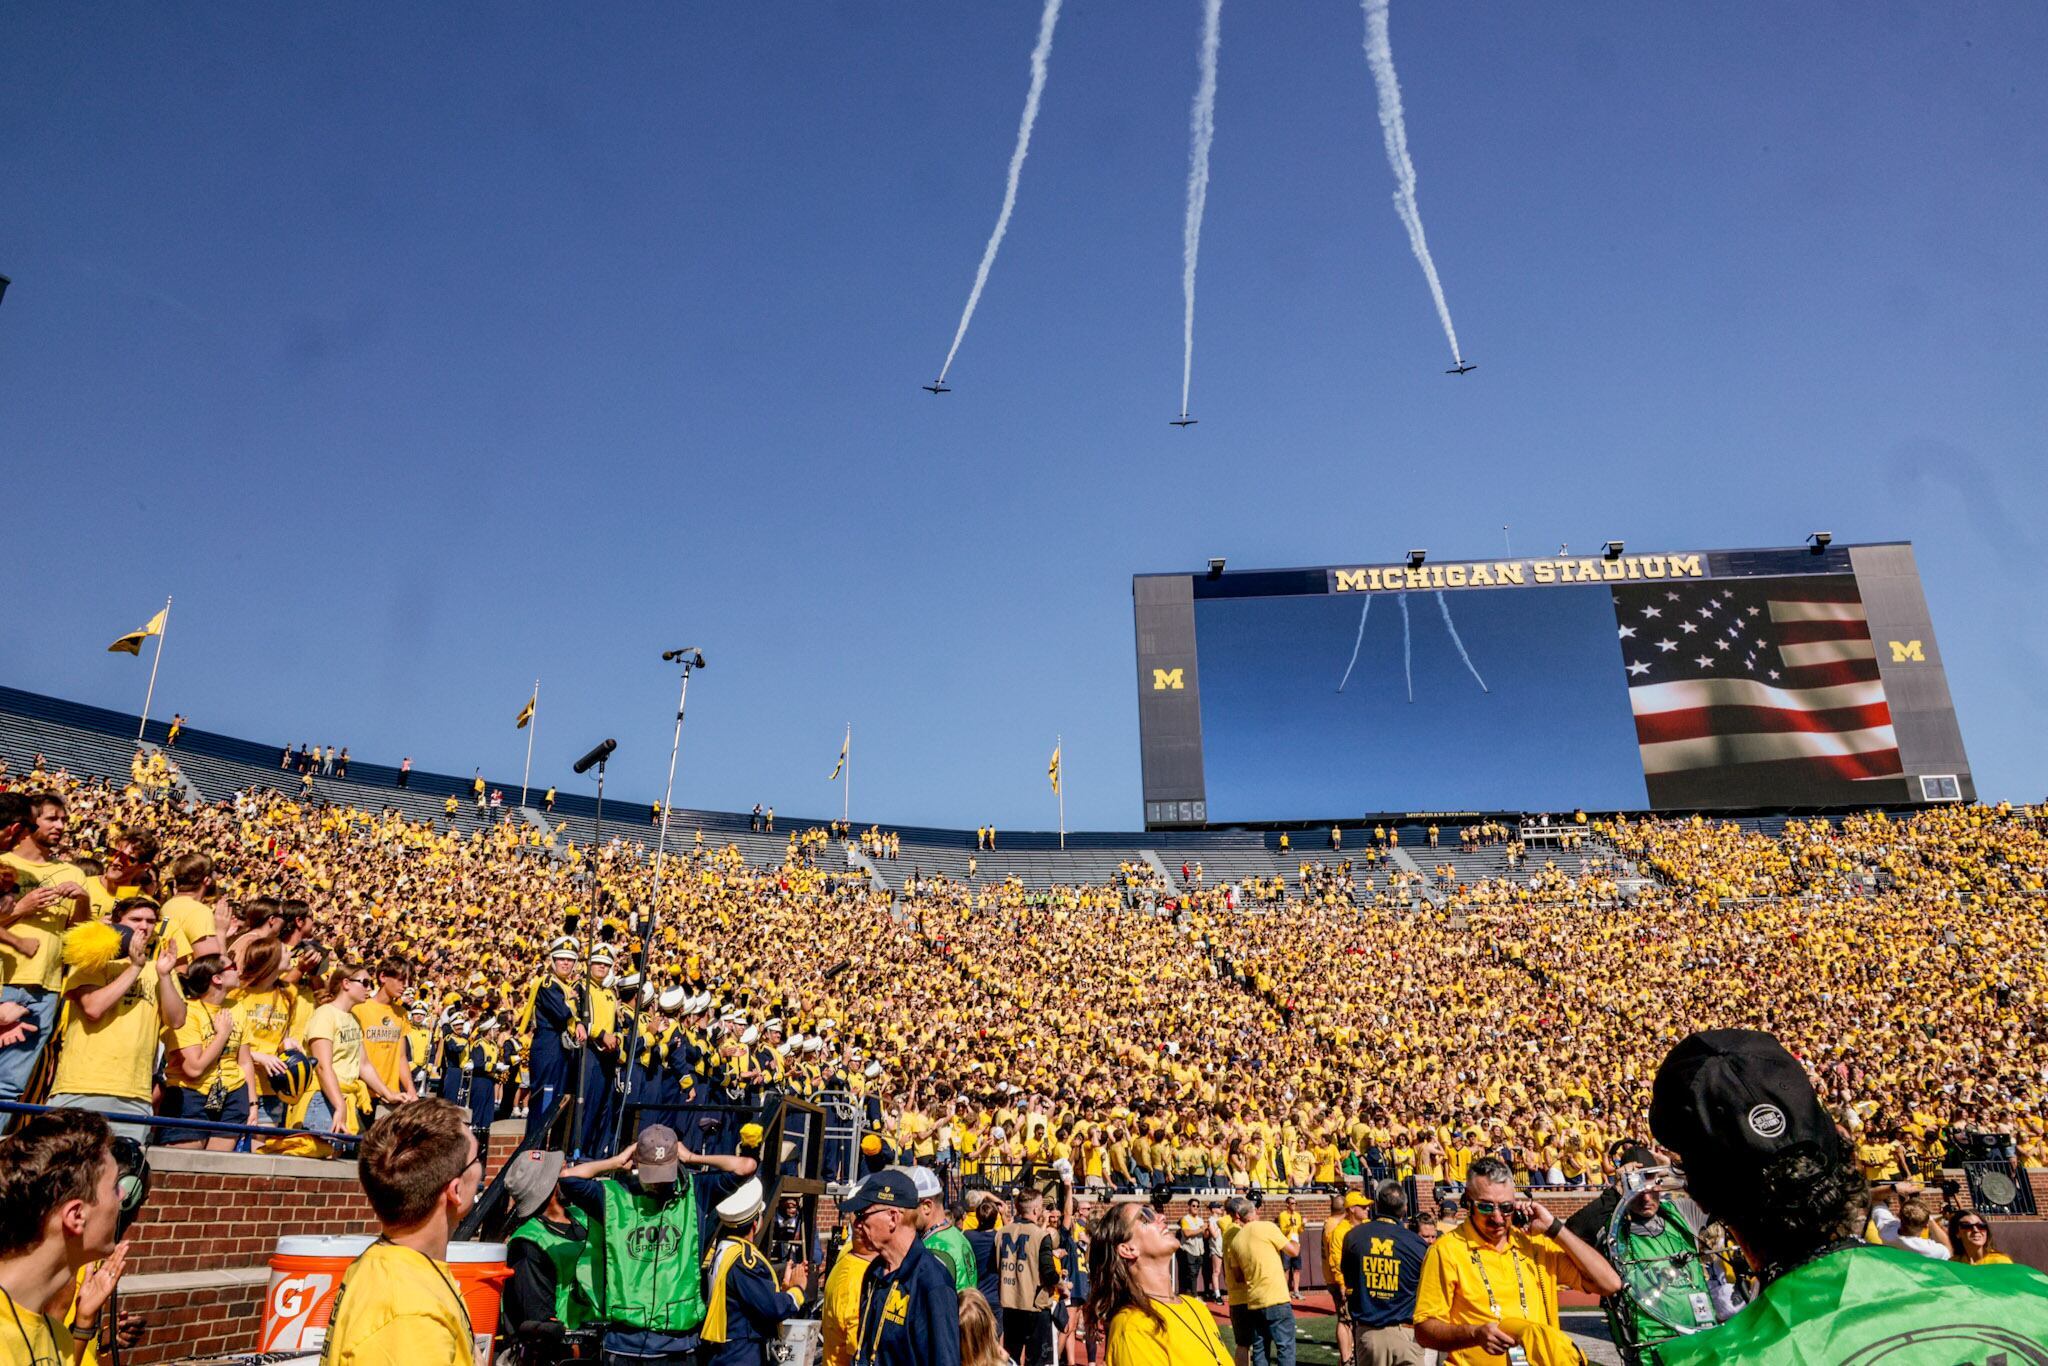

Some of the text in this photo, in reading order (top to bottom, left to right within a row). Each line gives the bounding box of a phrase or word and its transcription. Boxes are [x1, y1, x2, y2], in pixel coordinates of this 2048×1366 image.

[1335, 555, 1702, 592] MICHIGAN STADIUM
[1889, 640, 1925, 662] M
[1153, 668, 1184, 690] M
[1154, 802, 1205, 821] 11:58
[636, 1225, 670, 1244] FOX
[636, 1243, 671, 1253] SPORTS
[1002, 1233, 1029, 1261] M
[1370, 1237, 1394, 1256] M
[1363, 1256, 1401, 1276] EVENT
[1365, 1272, 1399, 1291] TEAM
[275, 1279, 304, 1317] G
[886, 1289, 910, 1319] M
